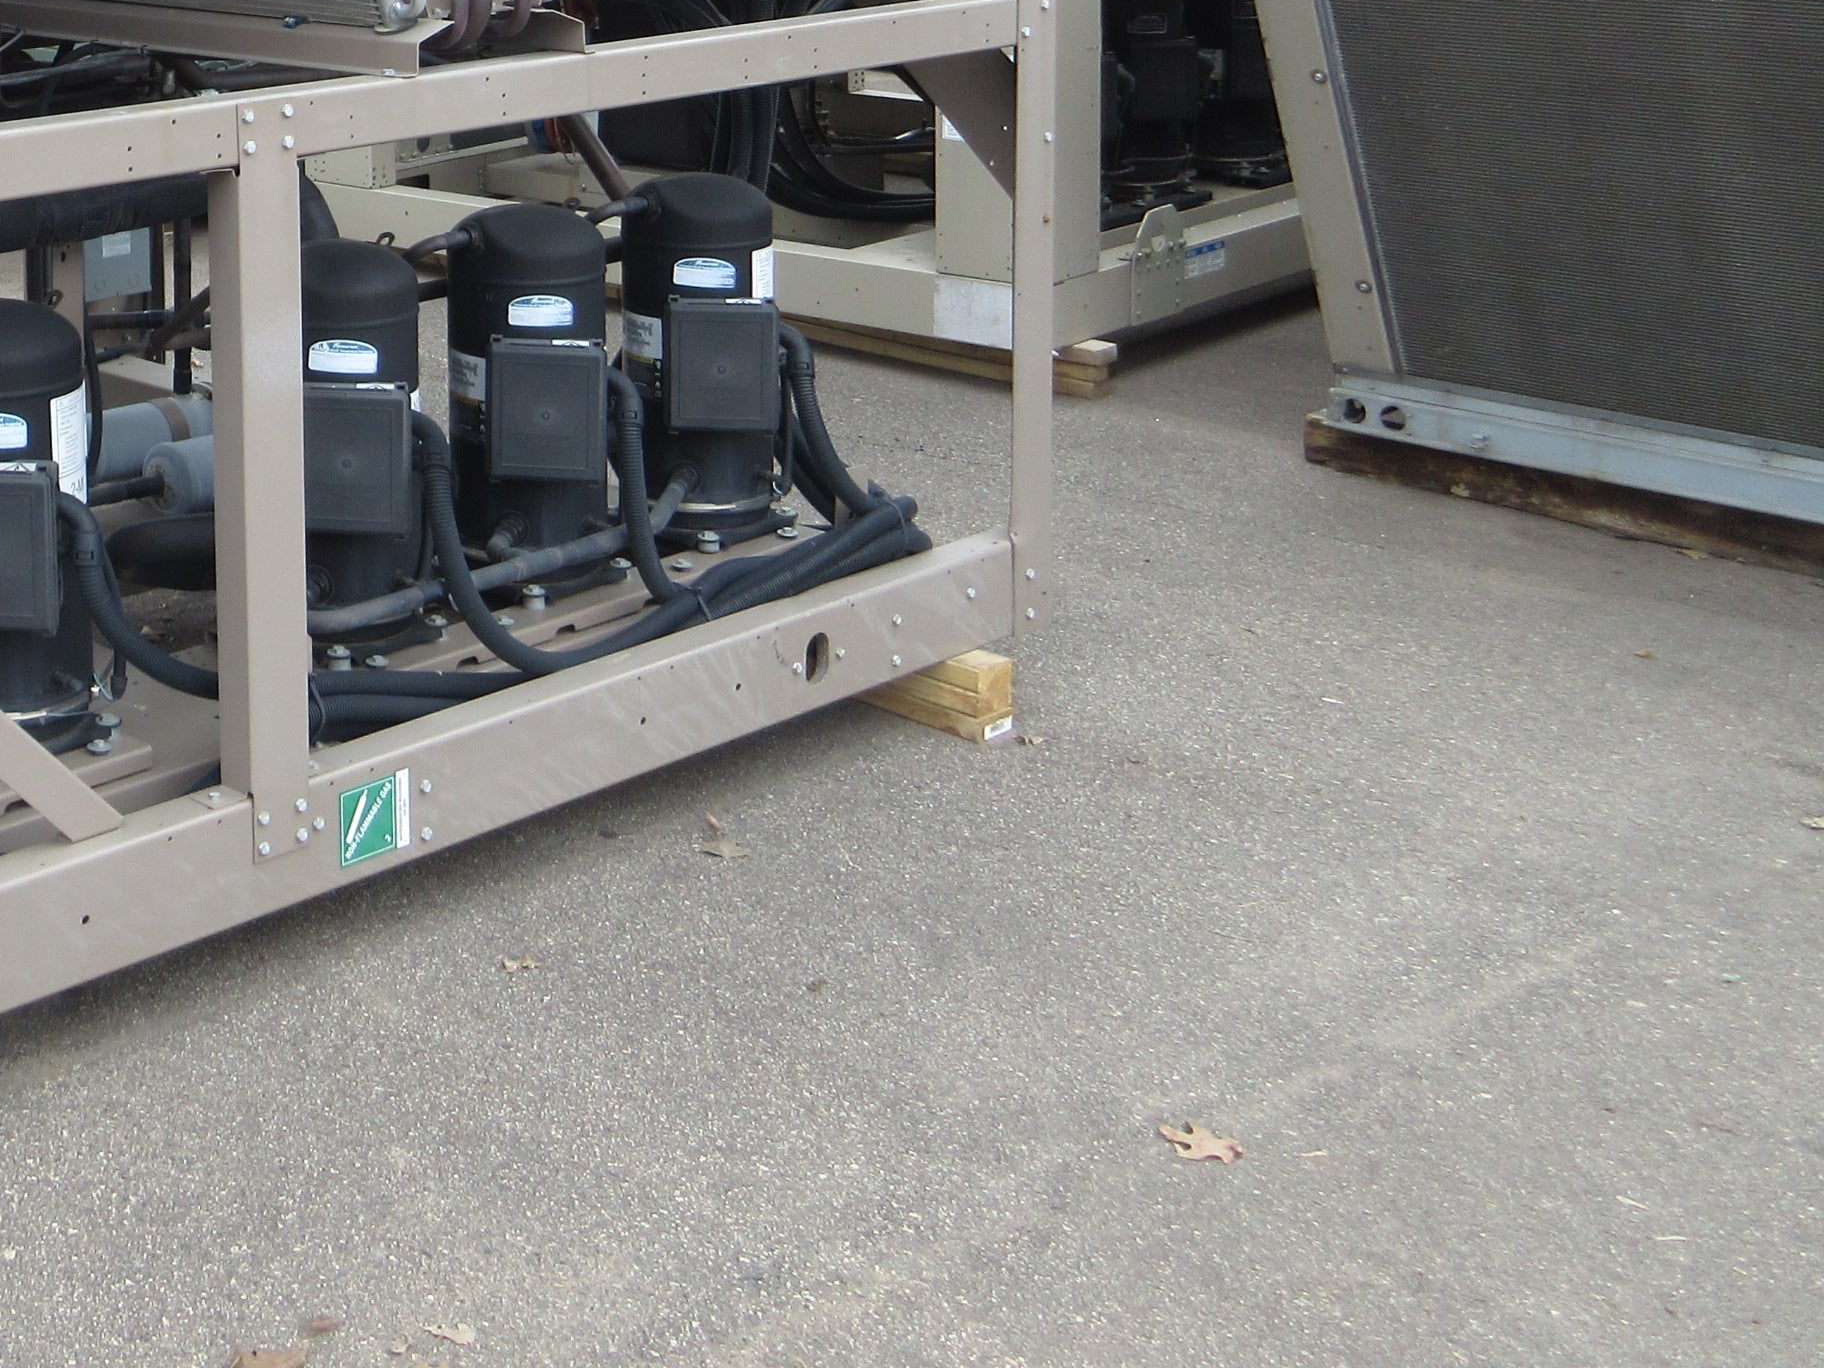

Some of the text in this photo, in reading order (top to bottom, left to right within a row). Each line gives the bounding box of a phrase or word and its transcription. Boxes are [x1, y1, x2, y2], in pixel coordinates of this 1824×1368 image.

[344, 781, 392, 860] NON-FLAMMABLE GAS
[384, 834, 391, 842] 2
